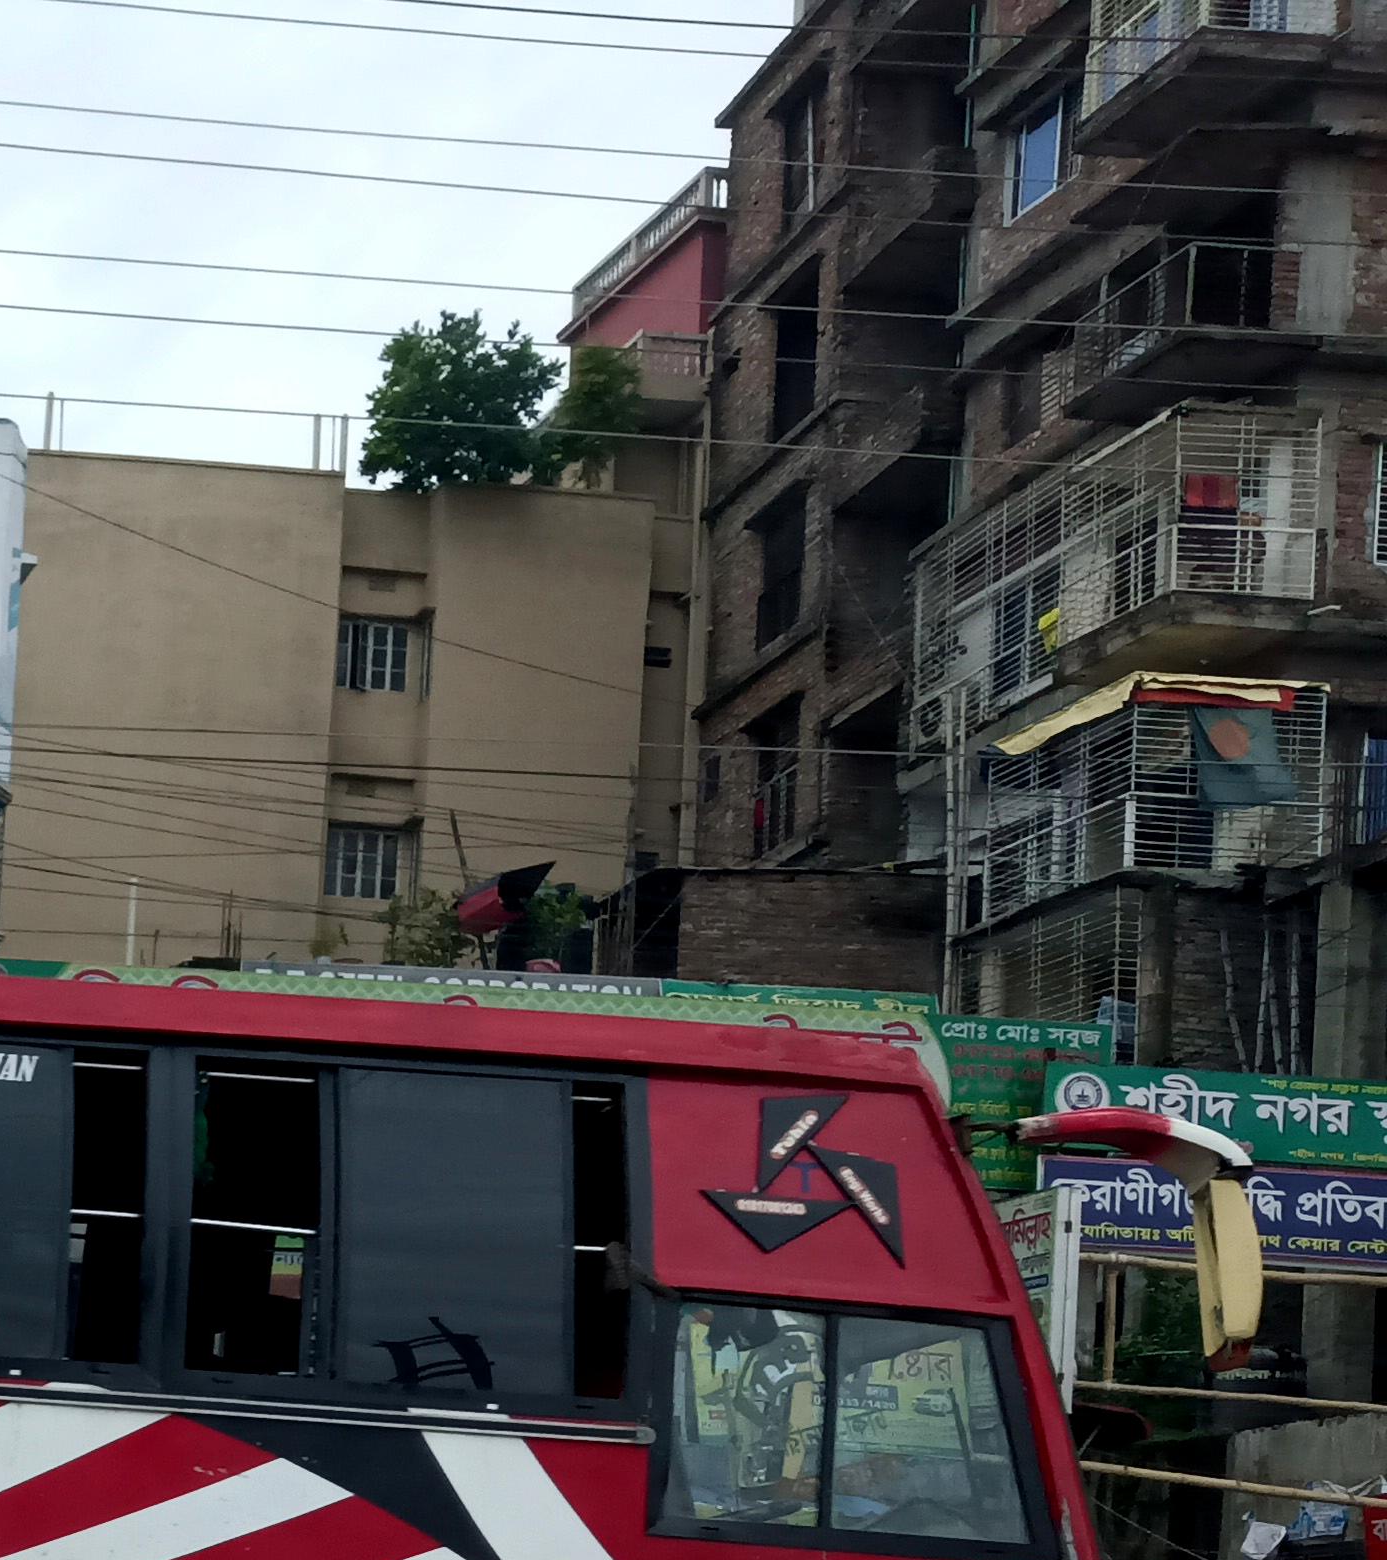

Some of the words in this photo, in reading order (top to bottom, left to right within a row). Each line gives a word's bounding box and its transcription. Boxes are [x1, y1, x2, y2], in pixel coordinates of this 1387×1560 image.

[941, 1020, 988, 1040] প্রোঃ
[995, 1024, 1040, 1043] মোঃ
[1046, 1026, 1102, 1050] সবুজ
[1118, 1073, 1239, 1129] শহীদ
[1249, 1091, 1356, 1136] নগর
